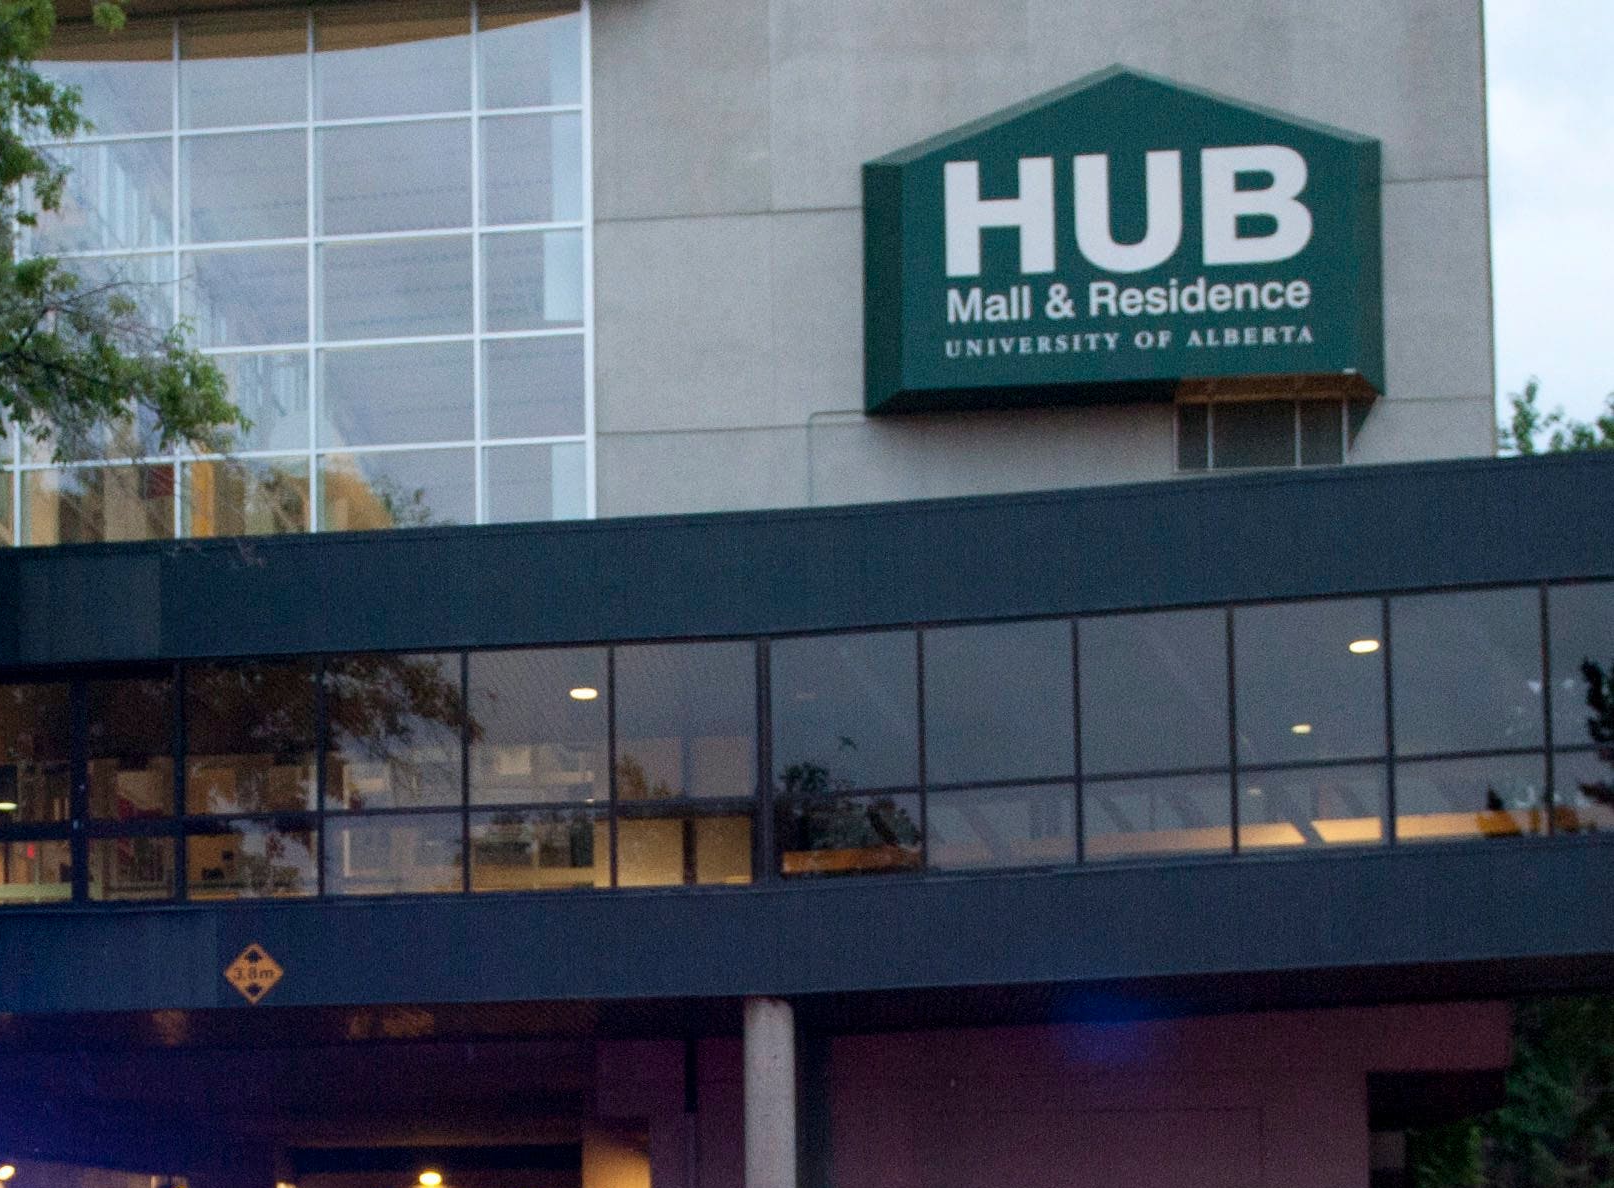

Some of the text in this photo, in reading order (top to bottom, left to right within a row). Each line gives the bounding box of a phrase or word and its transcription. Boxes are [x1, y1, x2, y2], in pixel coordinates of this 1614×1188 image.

[943, 144, 1313, 277] HUB
[946, 277, 1312, 324] Mall & Residence
[944, 324, 1315, 359] UNIVERSITY OF ALBERTA
